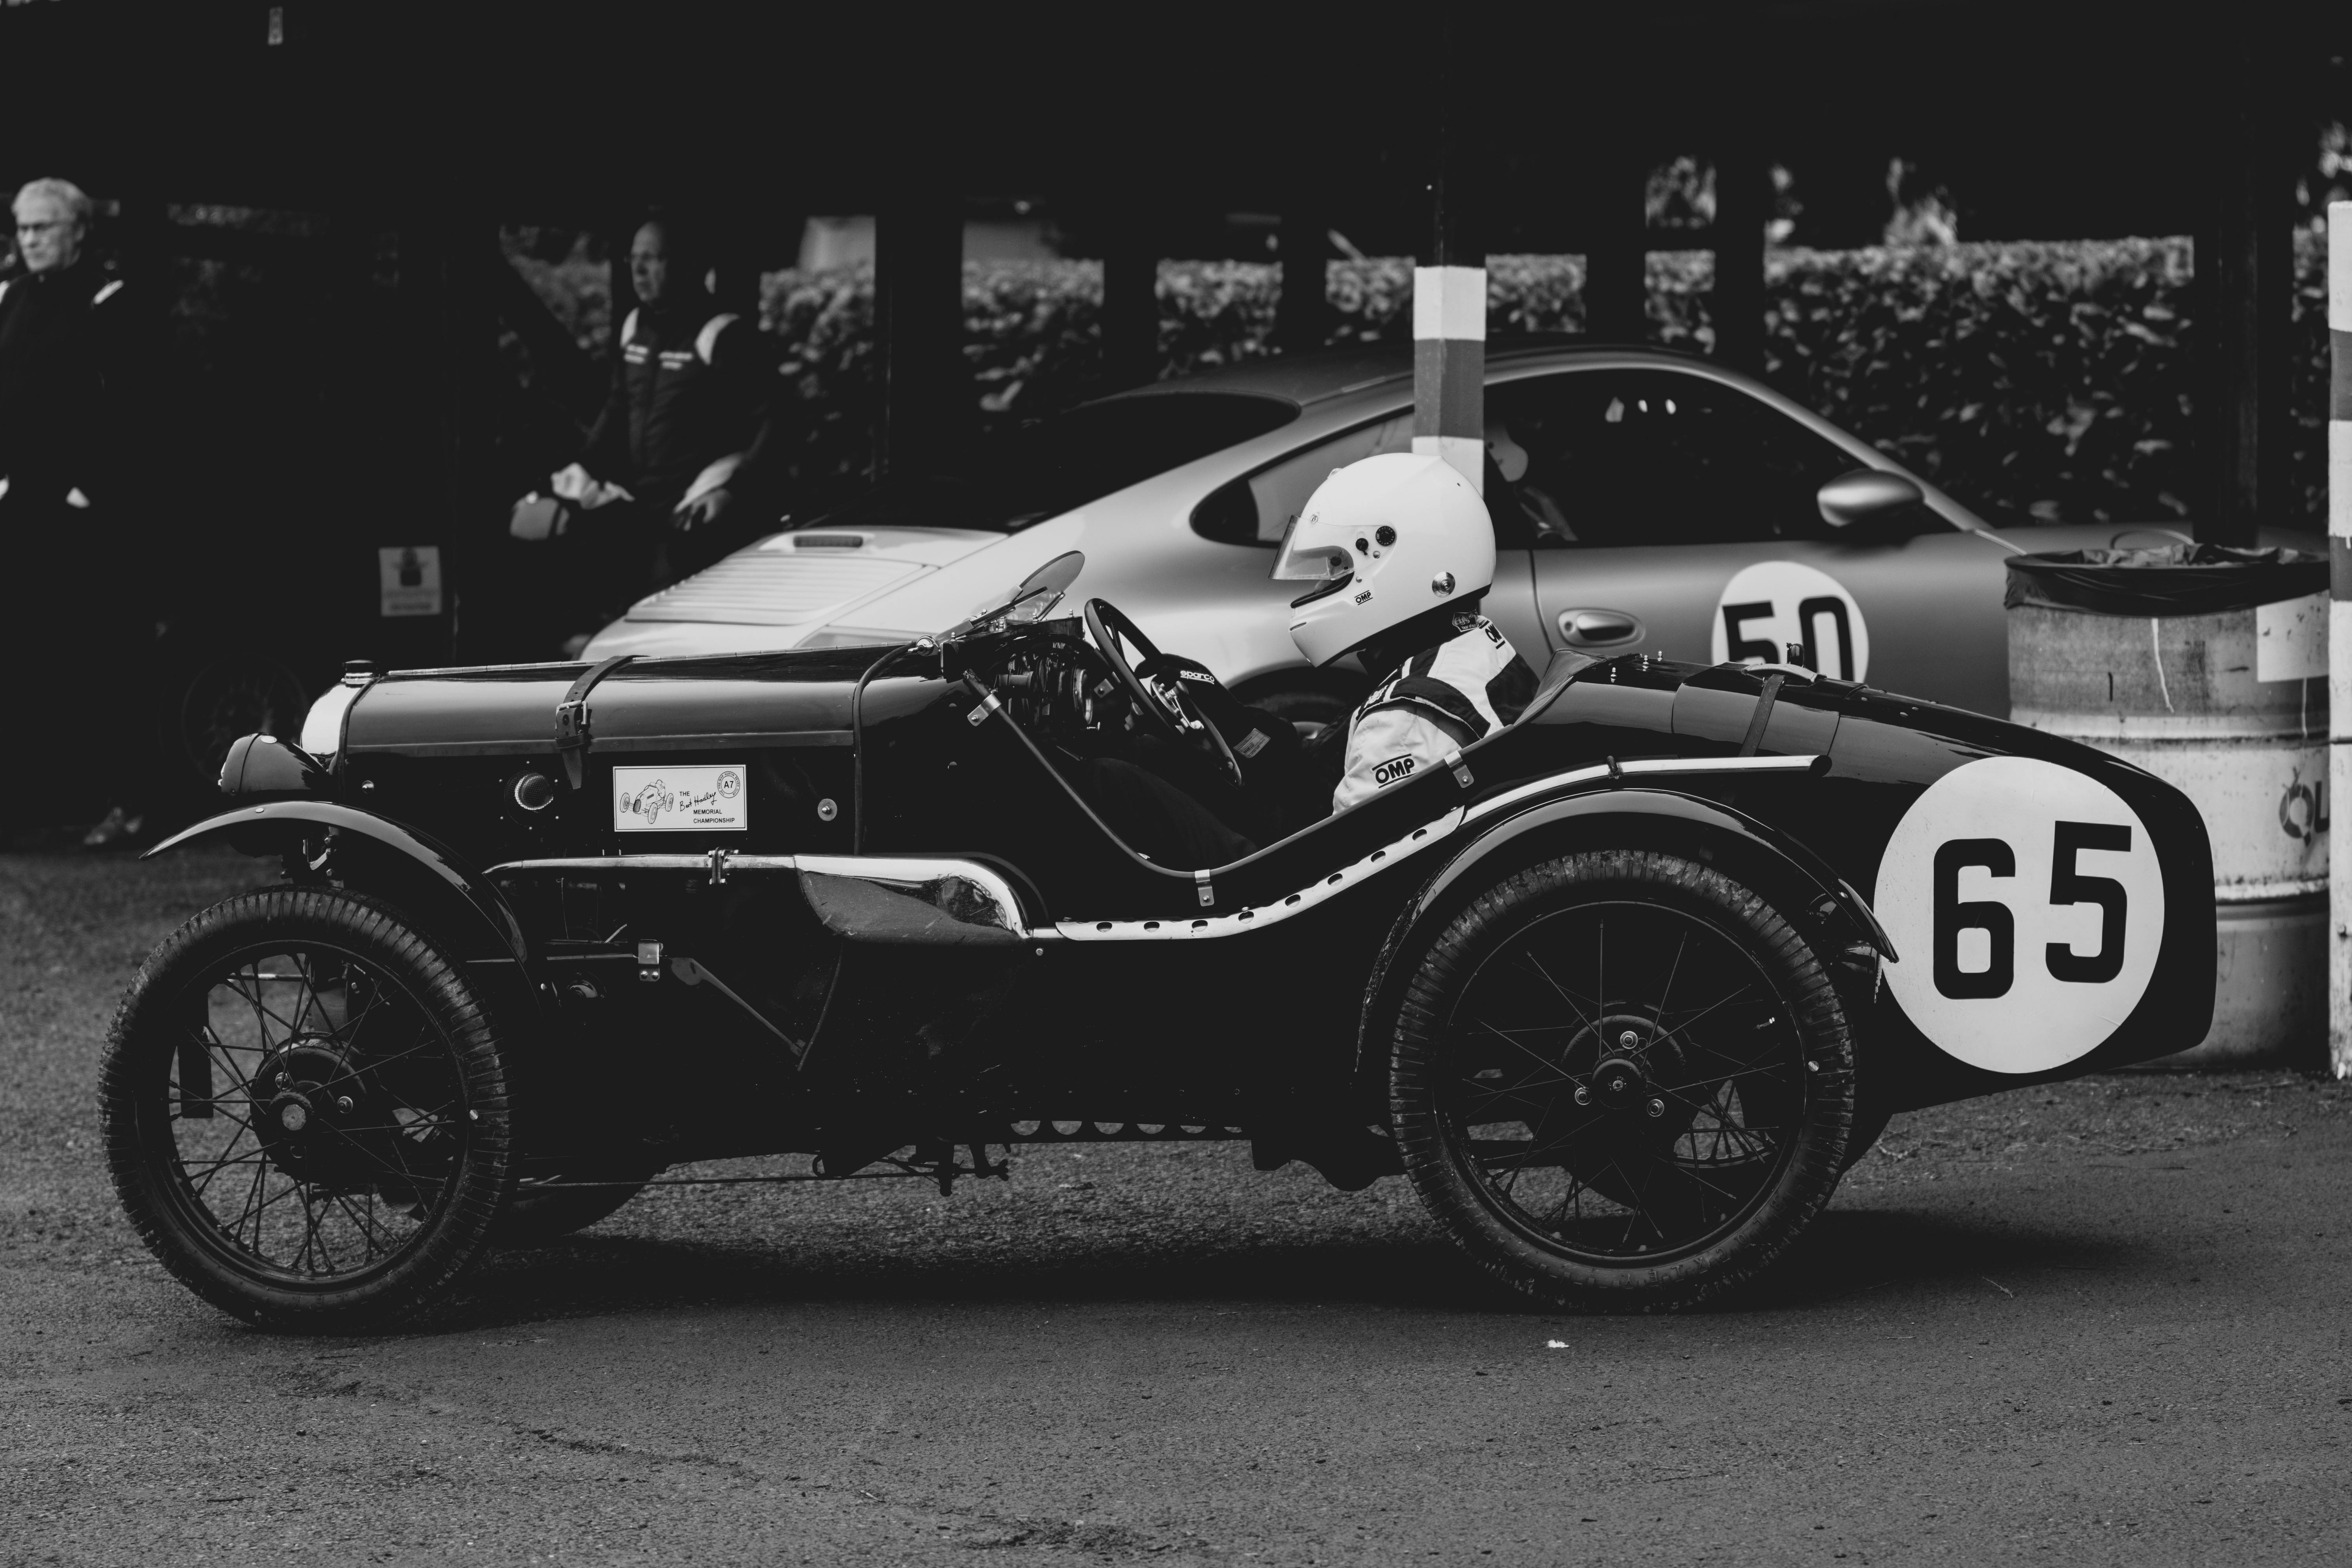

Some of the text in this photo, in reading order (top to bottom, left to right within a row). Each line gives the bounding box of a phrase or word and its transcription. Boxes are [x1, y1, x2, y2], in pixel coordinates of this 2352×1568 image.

[1355, 592, 1371, 603] OMP
[1485, 623, 1502, 643] OM
[1722, 595, 1854, 682] 50
[1180, 670, 1215, 682] sparco
[1375, 758, 1415, 784] OMP
[680, 792, 717, 812] Bert Hadley
[1933, 820, 2132, 1000] 65
